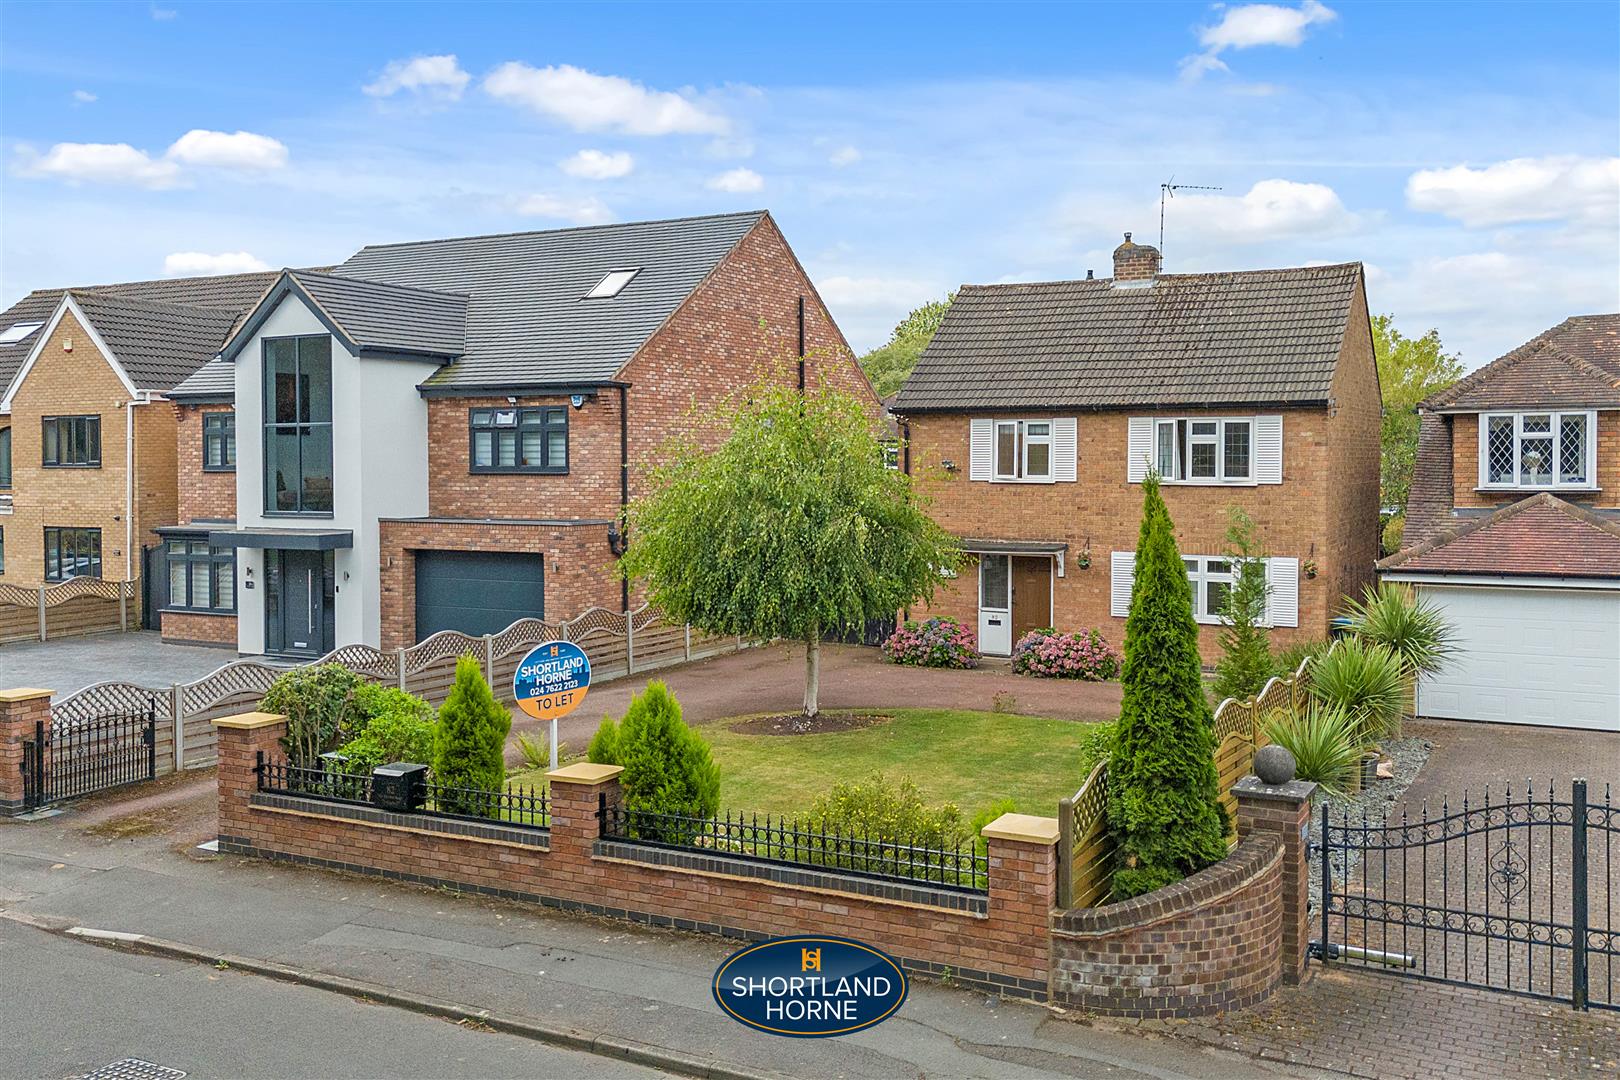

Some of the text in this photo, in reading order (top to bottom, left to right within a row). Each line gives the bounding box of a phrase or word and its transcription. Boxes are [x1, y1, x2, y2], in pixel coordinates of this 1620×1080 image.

[521, 657, 583, 677] SHORTLAND
[536, 669, 572, 686] HORNE
[530, 680, 578, 695] 024 7622 2123
[536, 693, 574, 711] TO LET
